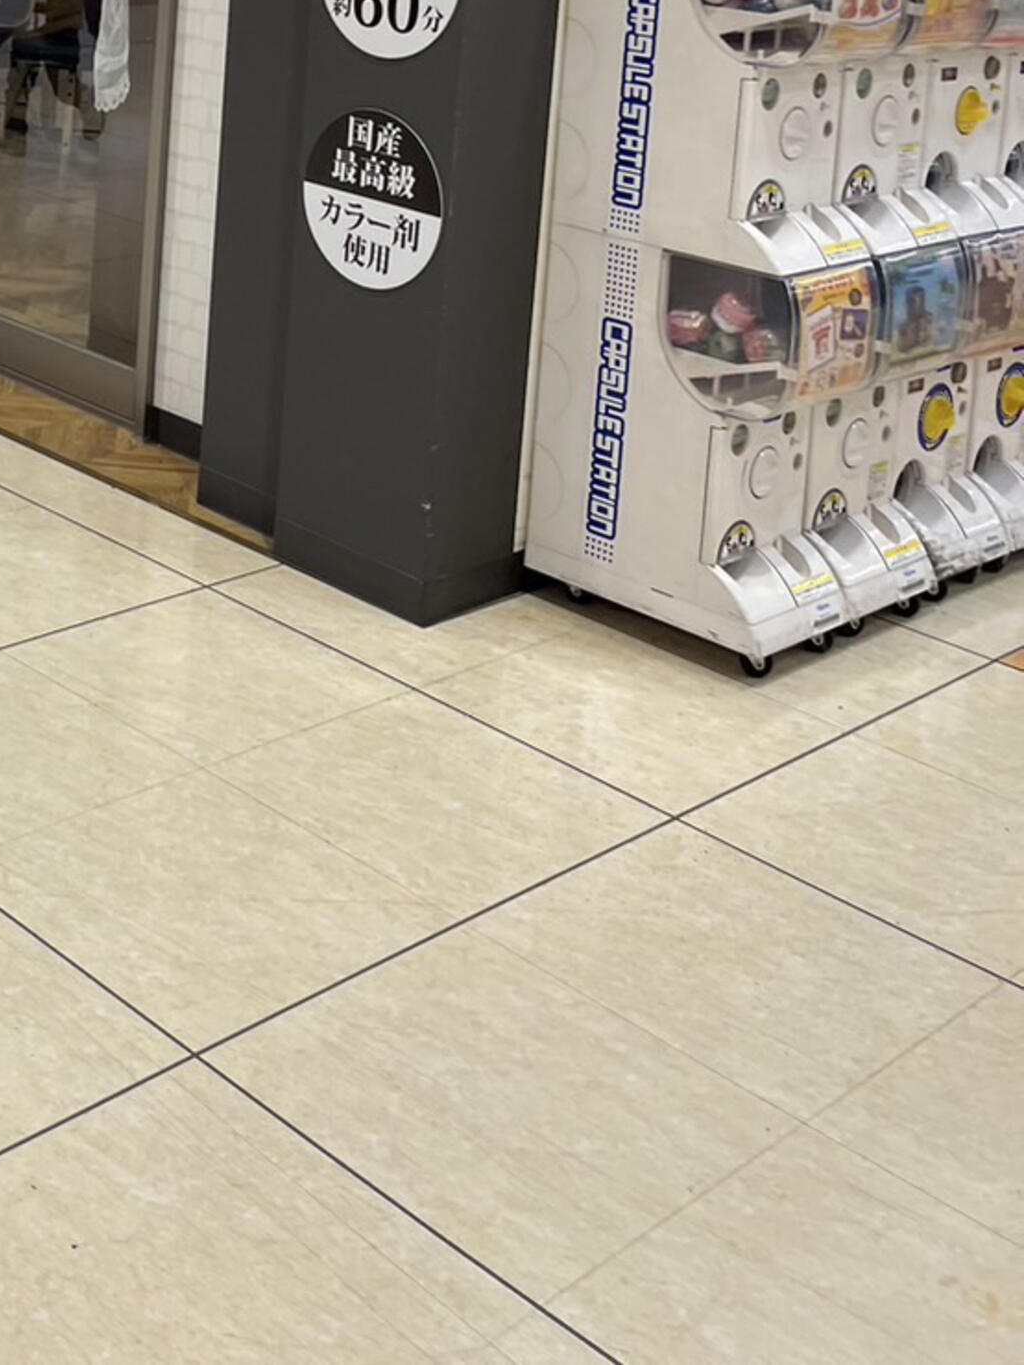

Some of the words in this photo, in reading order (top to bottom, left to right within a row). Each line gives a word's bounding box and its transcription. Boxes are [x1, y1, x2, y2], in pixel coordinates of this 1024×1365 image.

[331, 147, 416, 199] 最高級
[347, 114, 403, 158] 国産
[613, 101, 649, 208] STATION
[320, 194, 421, 252] カラー剤
[596, 319, 631, 435] CAPSULE
[587, 433, 622, 538] STATION
